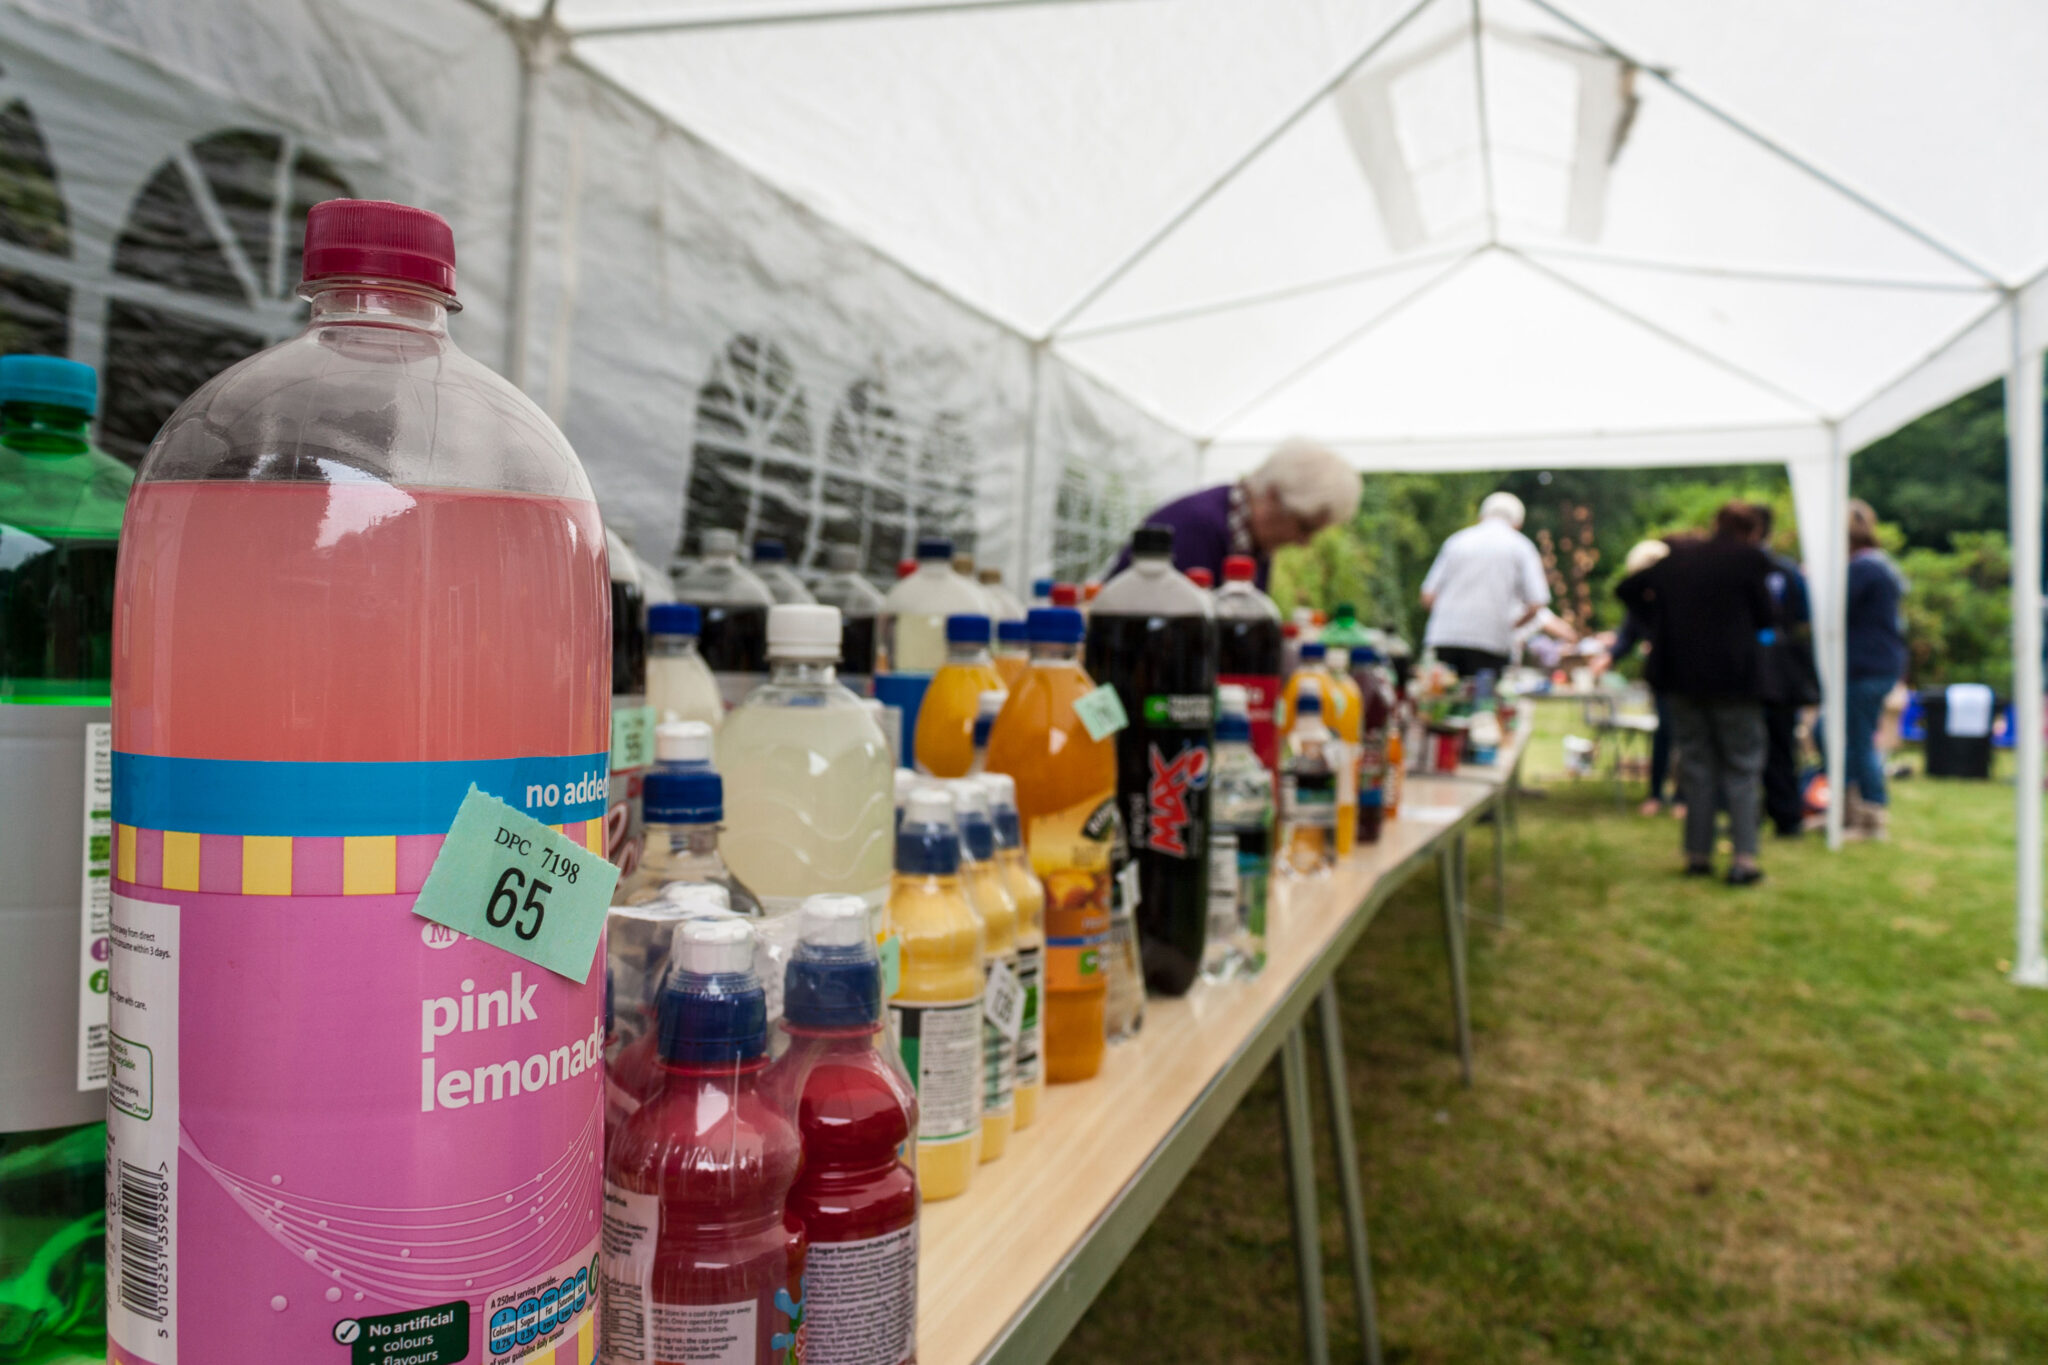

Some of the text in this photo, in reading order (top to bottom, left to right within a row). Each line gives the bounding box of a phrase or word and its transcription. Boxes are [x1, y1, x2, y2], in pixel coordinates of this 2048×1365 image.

[526, 768, 609, 808] no added
[494, 827, 580, 884] DPC 7198
[486, 867, 553, 941] 65
[150, 946, 154, 956] 3
[422, 971, 538, 1053] pink
[421, 1016, 605, 1112] lemonade
[157, 1182, 168, 1339] 5 010251 359296
[490, 1299, 496, 1309] A
[496, 1291, 517, 1308] 250ml
[517, 1284, 537, 1300] serving
[502, 1313, 507, 1322] 3
[522, 1303, 535, 1314] 0.3g
[545, 1306, 553, 1316] Fat
[369, 1310, 454, 1337] No artificial
[492, 1324, 516, 1338] Calories
[520, 1316, 536, 1328] Sugar
[383, 1334, 434, 1352] colours
[383, 1350, 439, 1365] flavours
